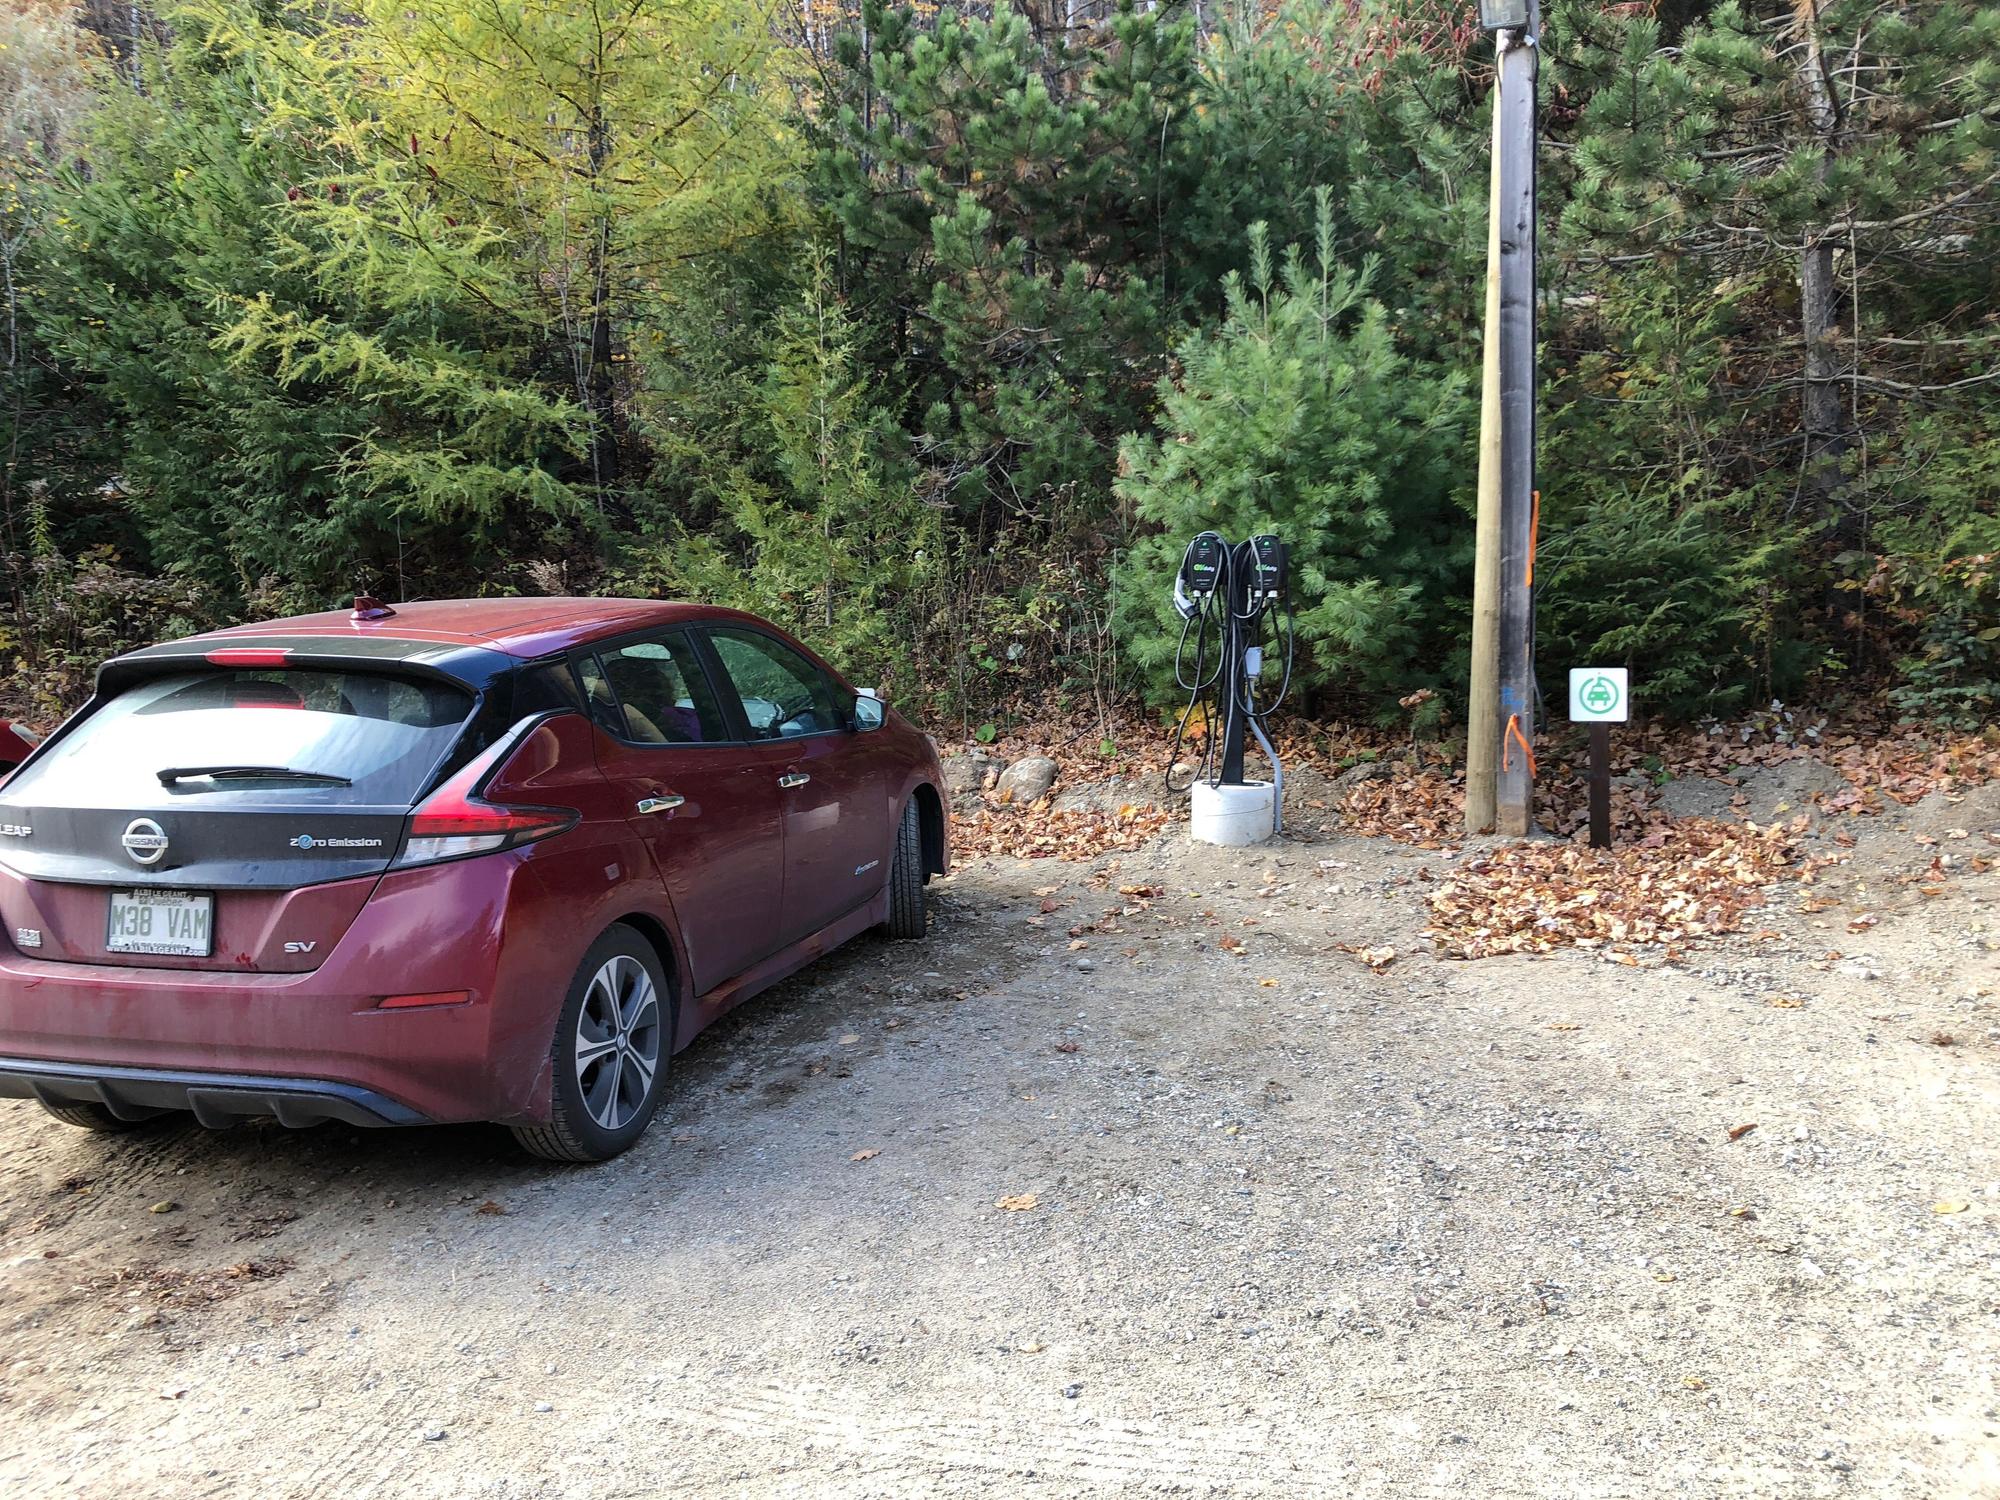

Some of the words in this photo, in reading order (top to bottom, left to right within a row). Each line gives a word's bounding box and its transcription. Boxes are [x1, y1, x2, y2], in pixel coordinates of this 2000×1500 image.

[125, 838, 162, 846] NISSAN
[327, 838, 383, 847] Emission
[111, 904, 153, 937] M38
[167, 907, 208, 940] VAM
[284, 941, 317, 953] SV
